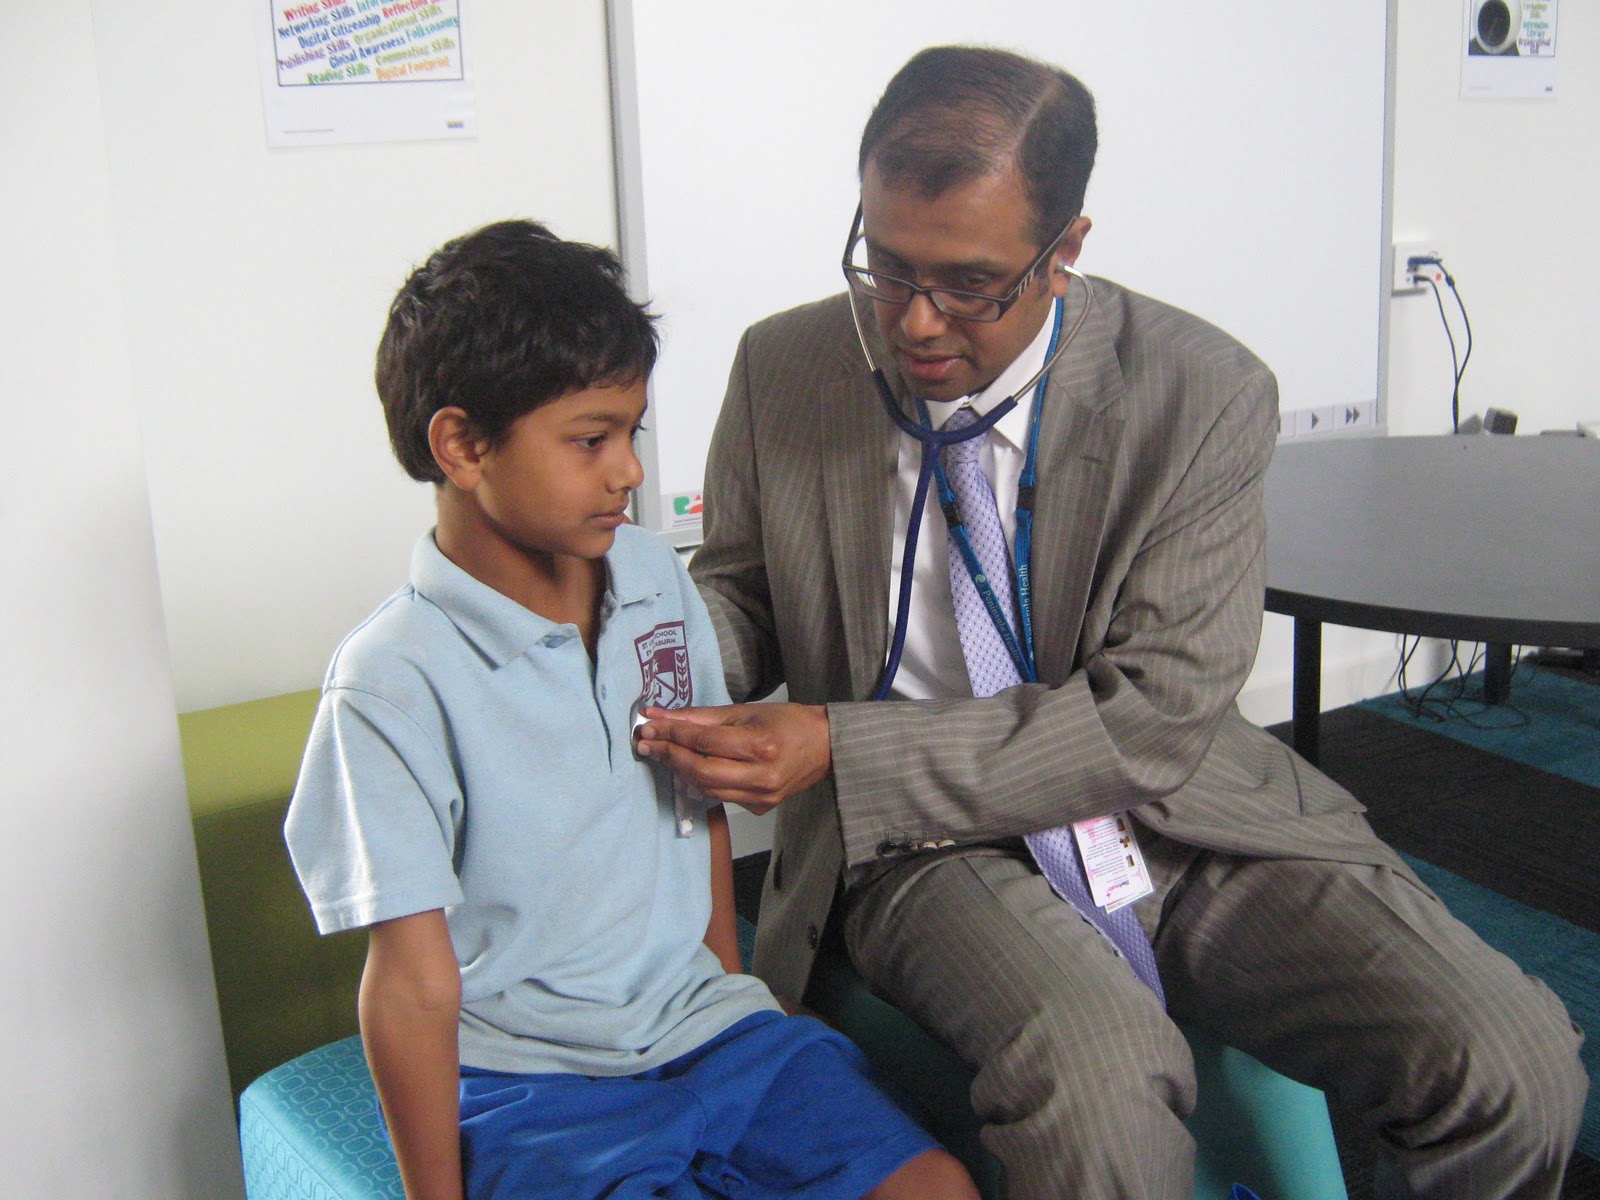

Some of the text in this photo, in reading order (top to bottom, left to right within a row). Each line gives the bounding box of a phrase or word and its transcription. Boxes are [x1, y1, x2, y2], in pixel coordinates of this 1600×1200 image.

[277, 14, 330, 39] Networking
[330, 5, 356, 22] Skills
[283, 2, 320, 21] Writing
[277, 46, 326, 71] Publishing
[326, 38, 351, 55] Skills
[418, 4, 443, 21] Skills
[297, 28, 331, 48] Digital
[330, 13, 381, 37] Citizenship
[329, 49, 359, 69] Global
[358, 35, 407, 60] Awareness
[1018, 564, 1030, 596] Health
[983, 589, 1006, 632] Peninsula
